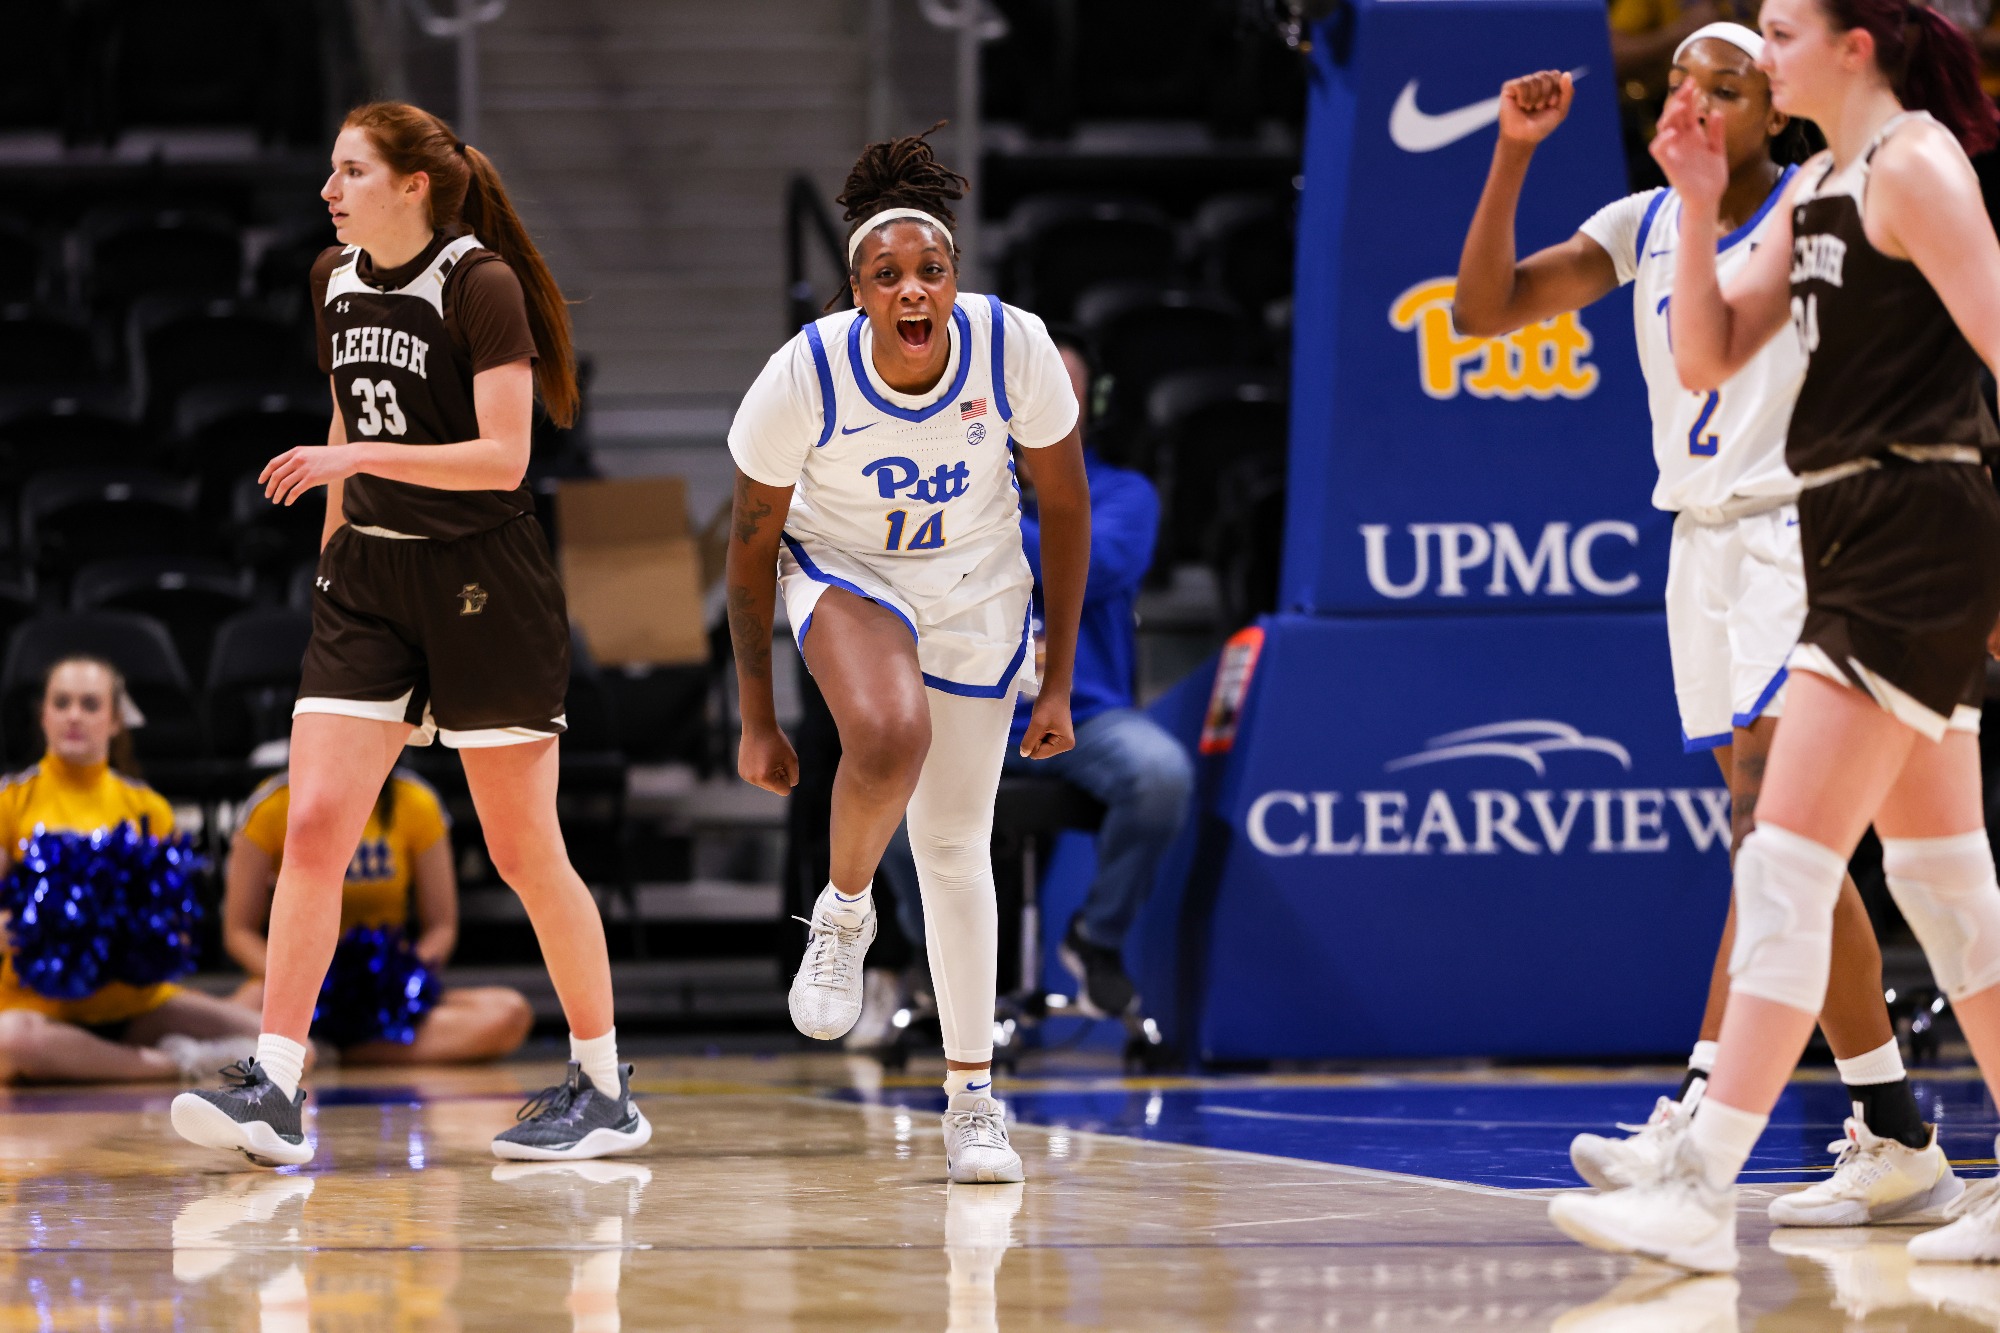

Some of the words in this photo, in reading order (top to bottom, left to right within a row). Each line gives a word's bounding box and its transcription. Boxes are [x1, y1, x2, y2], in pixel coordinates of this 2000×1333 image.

[331, 326, 429, 380] LEHIGH
[351, 378, 408, 436] 33
[1688, 386, 1721, 460] 2
[861, 456, 970, 504] Pitt
[884, 508, 946, 551] 14
[1358, 520, 1640, 599] UPMC
[1246, 789, 1733, 857] CLEARVIEW
